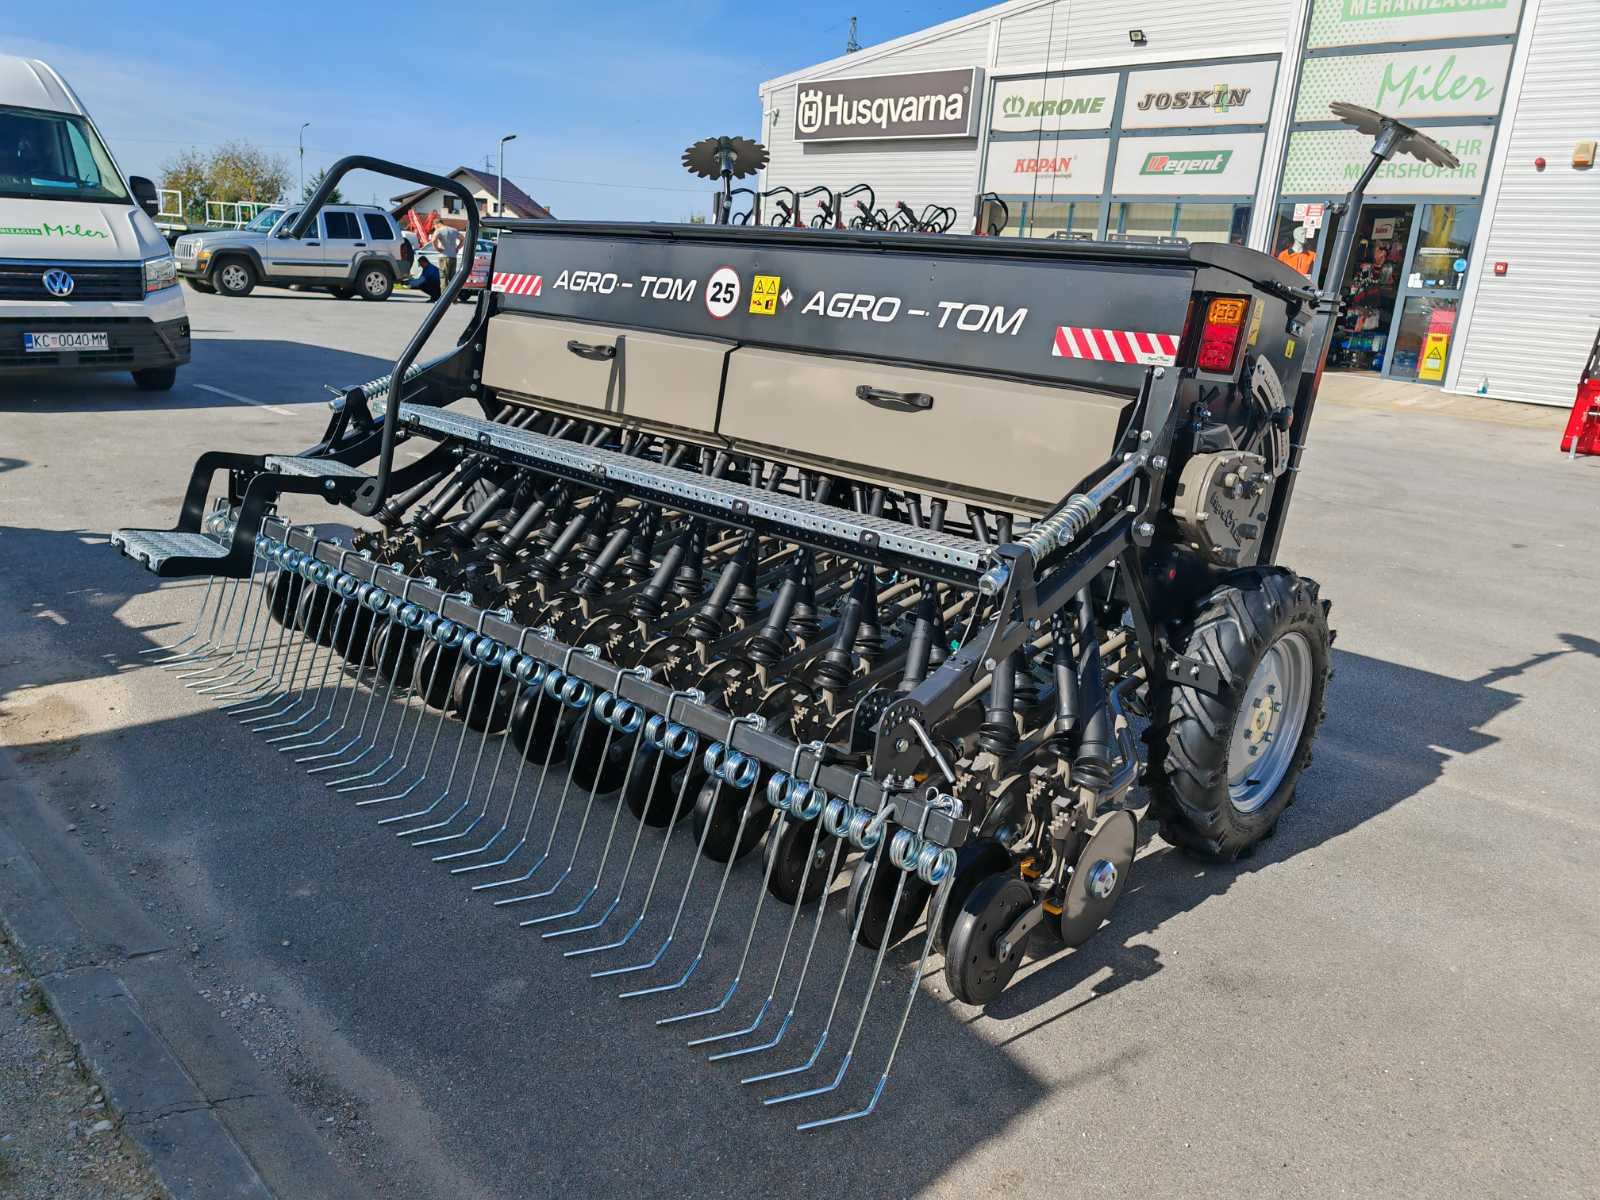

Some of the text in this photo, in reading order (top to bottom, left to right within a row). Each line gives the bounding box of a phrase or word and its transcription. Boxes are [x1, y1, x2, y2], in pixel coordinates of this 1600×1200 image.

[1375, 55, 1495, 108] Miler
[1025, 97, 1106, 117] KRONE
[1137, 88, 1251, 111] JOSKIN
[824, 93, 963, 129] Husqvarna
[1014, 157, 1072, 173] KRPAN
[1146, 153, 1223, 174] Regent
[1343, 162, 1478, 178] MIERSHOP.HR
[43, 223, 108, 239] Miler
[552, 270, 618, 294] AGRO
[640, 276, 698, 302] TOM
[709, 281, 736, 304] 25
[801, 290, 902, 323] AGRO
[937, 301, 1029, 336] TOM
[34, 334, 50, 348] KC
